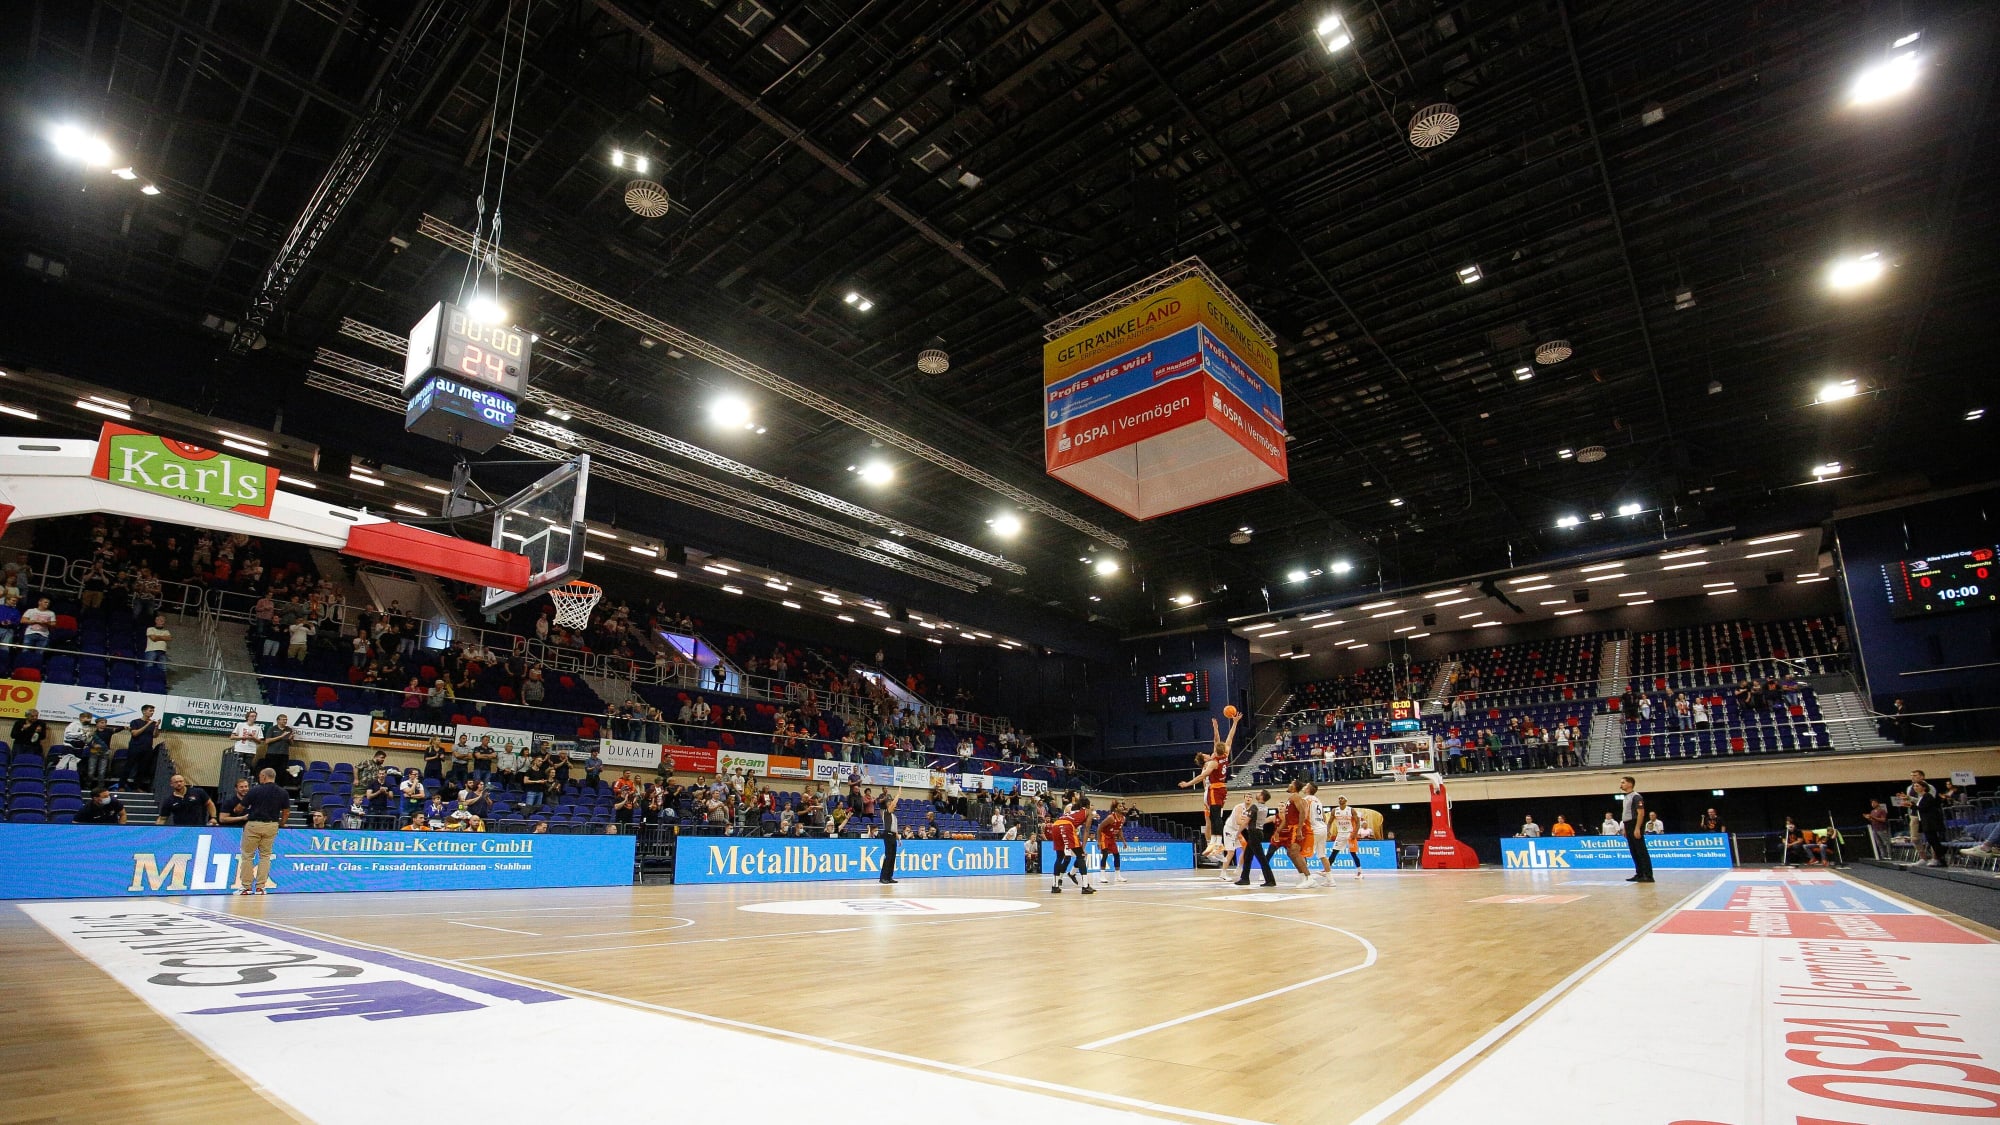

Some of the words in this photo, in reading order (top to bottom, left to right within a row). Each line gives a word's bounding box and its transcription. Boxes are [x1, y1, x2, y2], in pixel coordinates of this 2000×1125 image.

[1058, 300, 1181, 363] GETRÄNKELAND
[462, 344, 505, 382] 24
[1050, 379, 1090, 401] Profis
[1092, 368, 1119, 383] wie
[1122, 351, 1152, 371] wir!
[1073, 424, 1109, 446] OSPA
[1118, 396, 1190, 430] Vermögen
[1223, 403, 1244, 430] OSPA
[1247, 423, 1281, 458] Vermögen
[118, 446, 258, 500] Karls
[1977, 567, 1988, 578] 0
[1920, 577, 1931, 588] 0
[1937, 585, 1979, 600] 10:00
[85, 691, 126, 704] FSH
[1168, 695, 1186, 703] 10:00
[187, 700, 210, 710] HIER
[1395, 709, 1407, 719] 24
[187, 717, 213, 726] NEUE
[293, 711, 354, 732] ABS
[390, 720, 453, 736] LEHWALD
[608, 745, 654, 759] DUKATH
[733, 757, 765, 768] team
[1021, 780, 1047, 792] BERG
[310, 836, 477, 852] Metallbau-Kettner
[481, 839, 534, 853] GmbH
[1683, 837, 1725, 847] GmbH
[947, 846, 1011, 871] GmbH
[1273, 857, 1289, 867] für
[1331, 859, 1354, 867] eam
[292, 862, 328, 871] Metall
[338, 862, 362, 871] Glas
[371, 862, 487, 871] Fassadenkonstruktionen
[494, 861, 532, 871] Stahlbau
[1779, 940, 1922, 1001] Vermögen
[1784, 1016, 2000, 1119] OSPA
